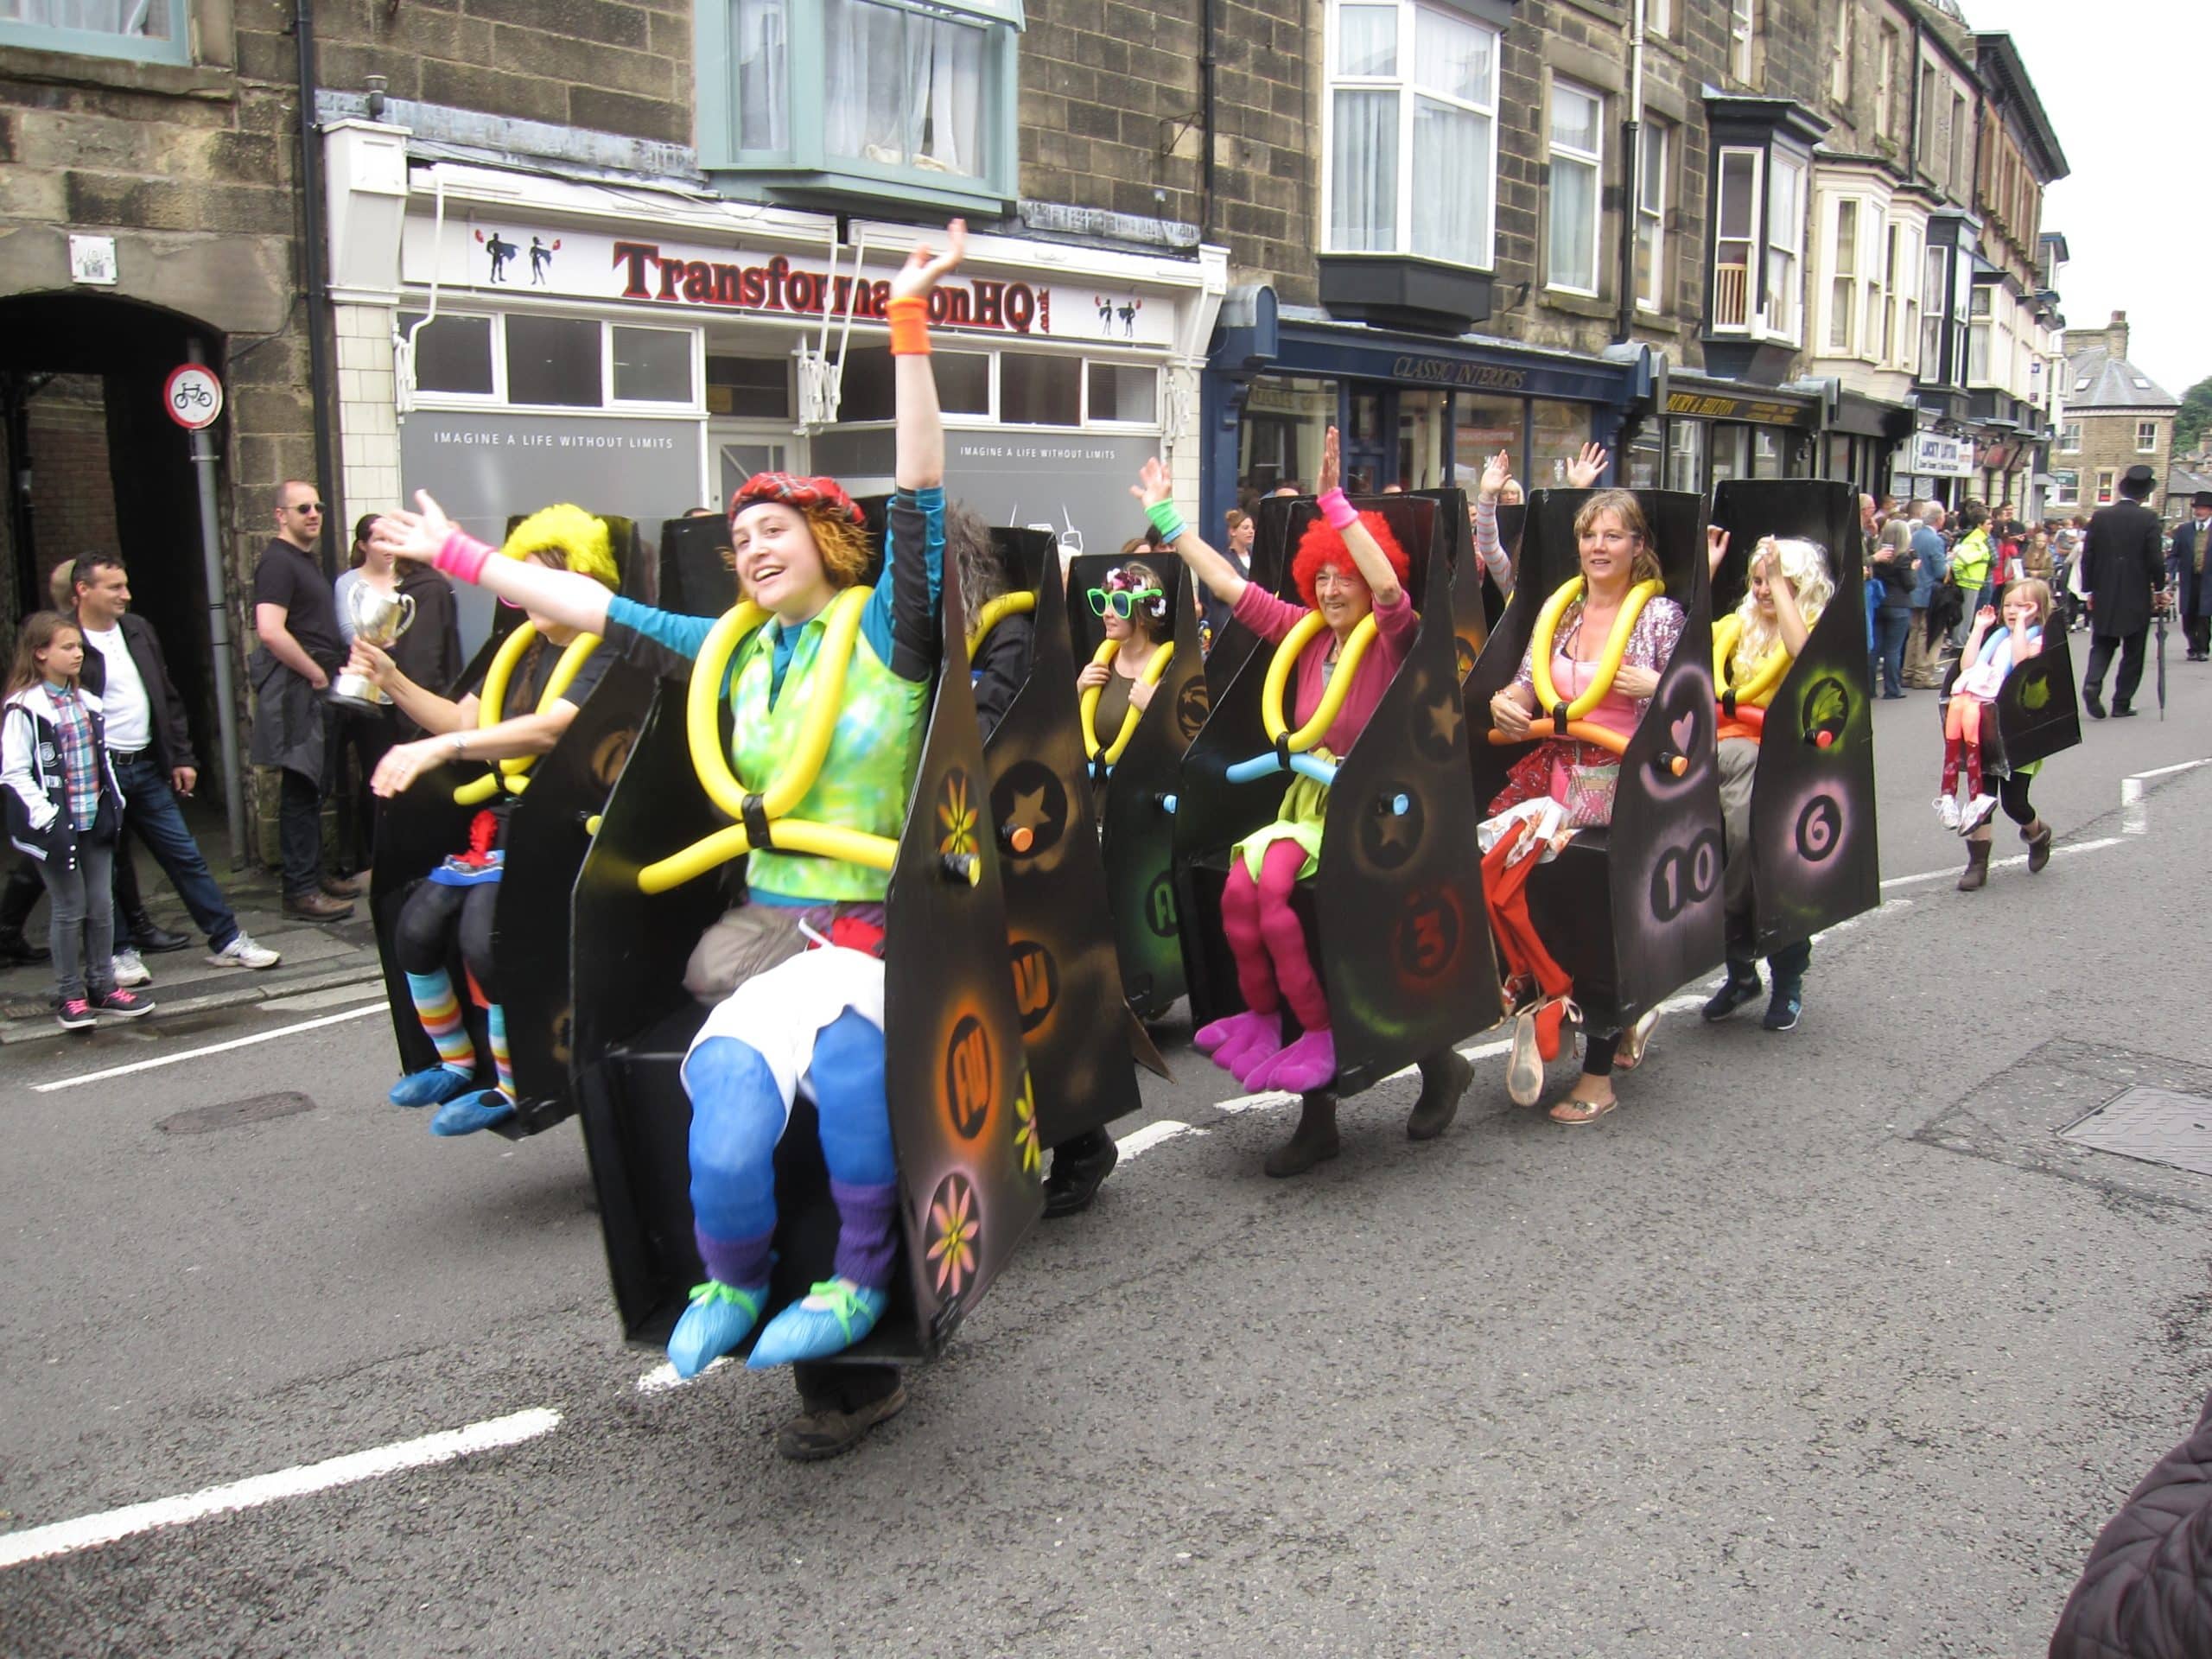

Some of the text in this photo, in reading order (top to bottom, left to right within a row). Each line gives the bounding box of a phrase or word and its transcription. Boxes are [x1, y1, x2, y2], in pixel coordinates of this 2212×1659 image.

[613, 241, 1036, 334] TransformaonHQ
[1393, 355, 1527, 389] CLASSIC INTERIORS
[434, 432, 673, 449] IMAGINE A LIFE WITHOUT LIMITS
[960, 446, 1116, 460] IMAGINE A LIFE WITHOUT LIMITS
[1804, 804, 1830, 851] 6
[1665, 841, 1714, 911] 10
[1414, 908, 1446, 968] 3
